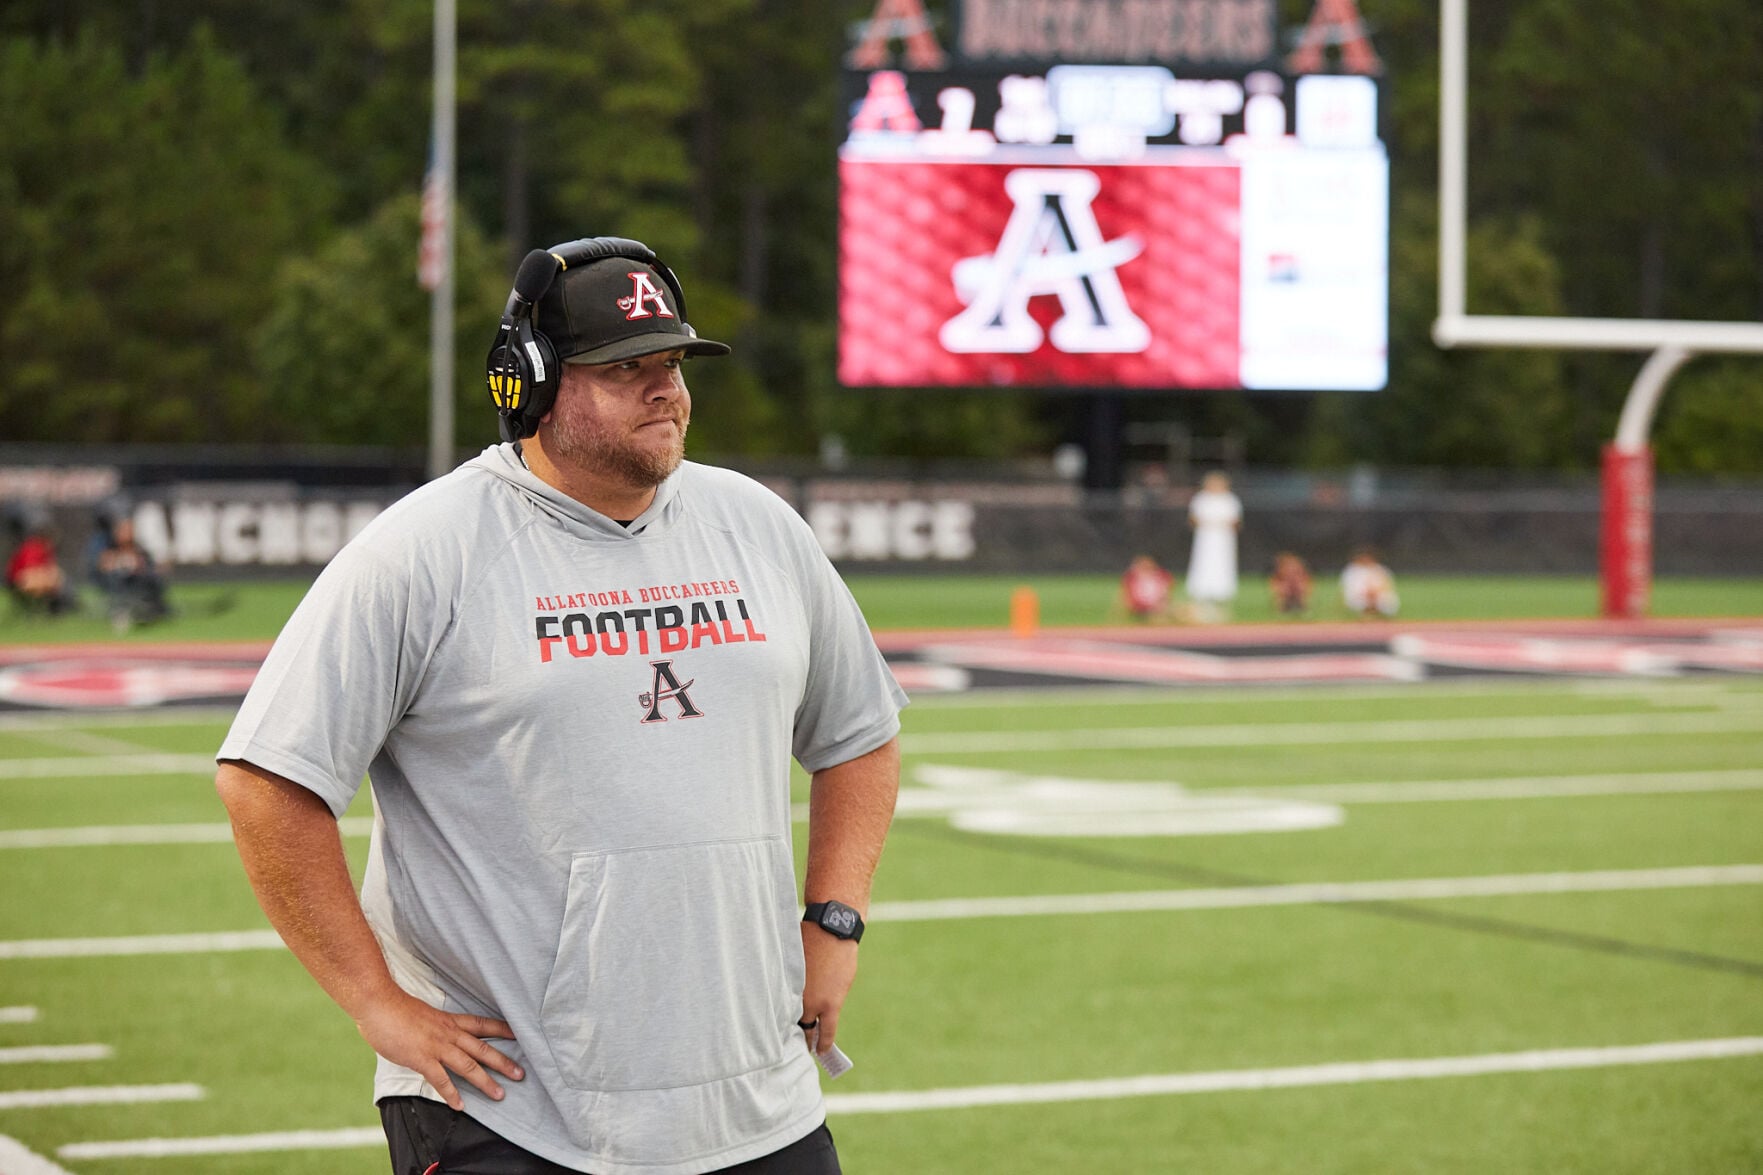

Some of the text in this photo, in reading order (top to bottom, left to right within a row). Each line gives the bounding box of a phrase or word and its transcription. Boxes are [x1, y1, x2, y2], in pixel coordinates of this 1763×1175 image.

[938, 168, 1152, 353] A
[625, 271, 675, 321] A
[536, 579, 741, 611] ALLATOONA BUCCANEERS
[535, 598, 767, 663] FOOTBALL
[640, 658, 705, 724] A
